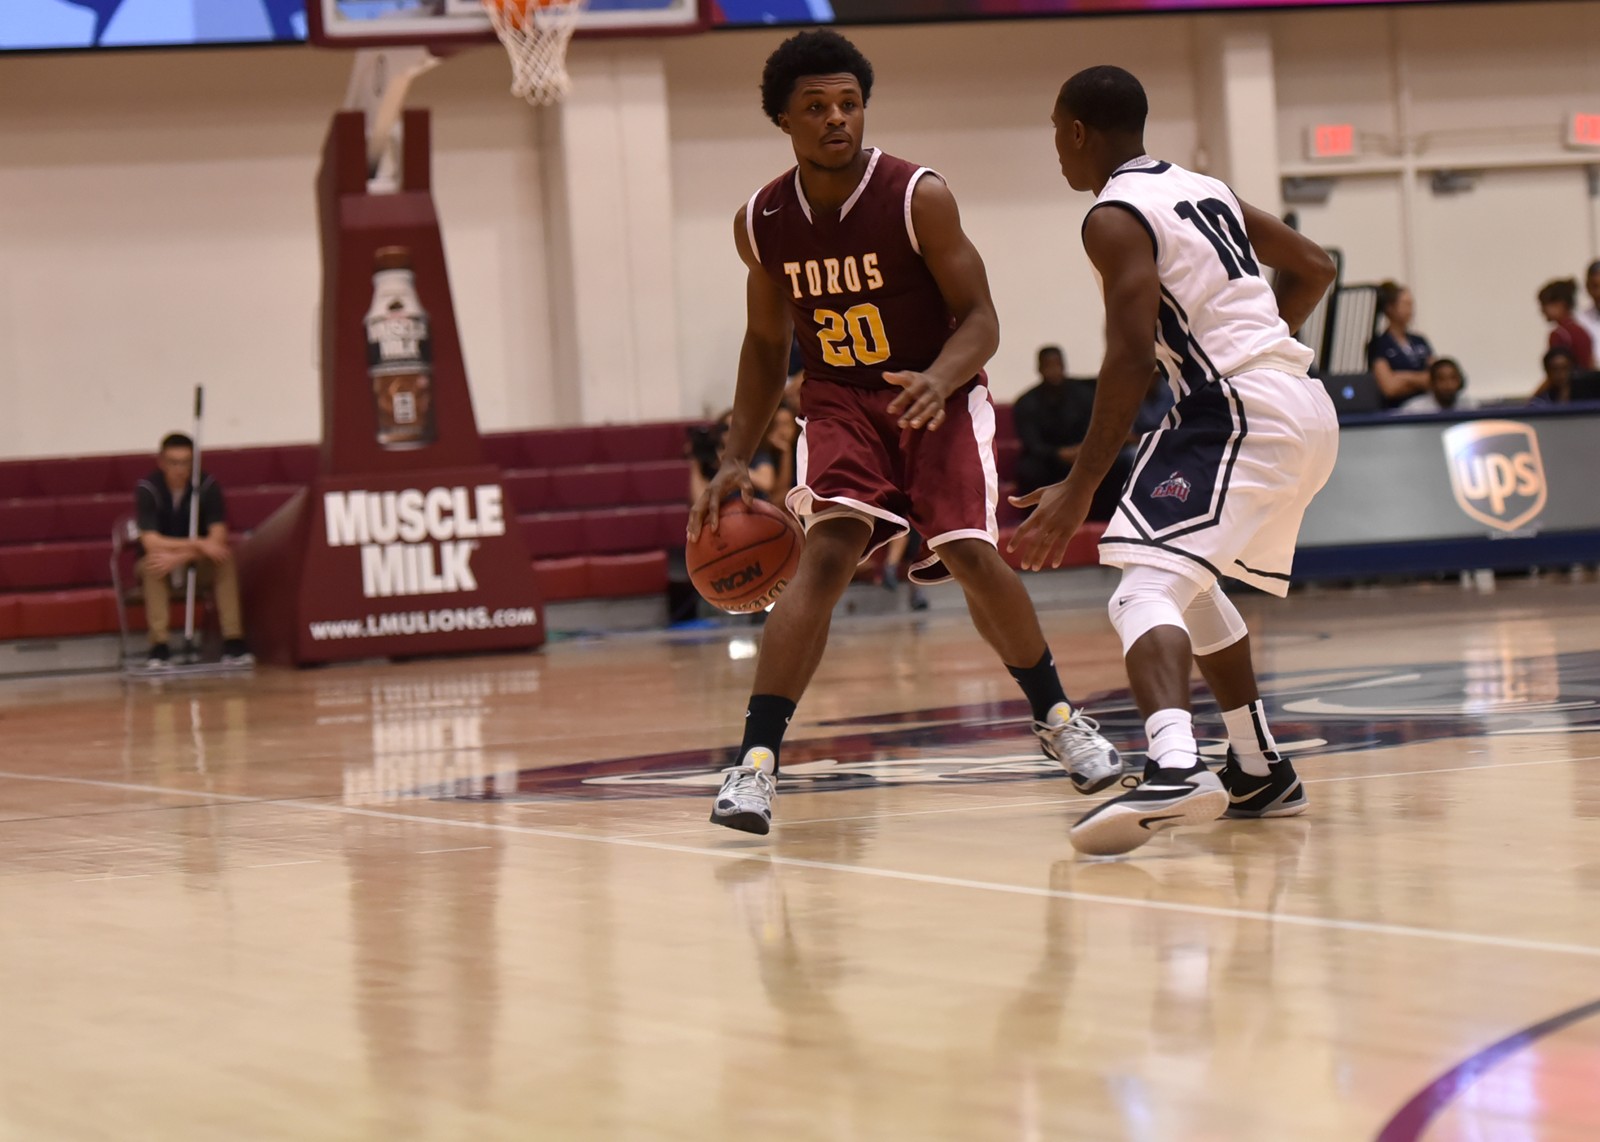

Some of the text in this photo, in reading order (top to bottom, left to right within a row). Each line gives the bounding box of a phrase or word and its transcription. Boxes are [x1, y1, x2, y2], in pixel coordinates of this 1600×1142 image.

[1174, 198, 1259, 280] 10
[784, 253, 884, 298] TOROS
[814, 303, 891, 367] 20
[324, 485, 505, 546] MUSCLE
[1150, 484, 1191, 502] LMU
[361, 541, 478, 597] MILK
